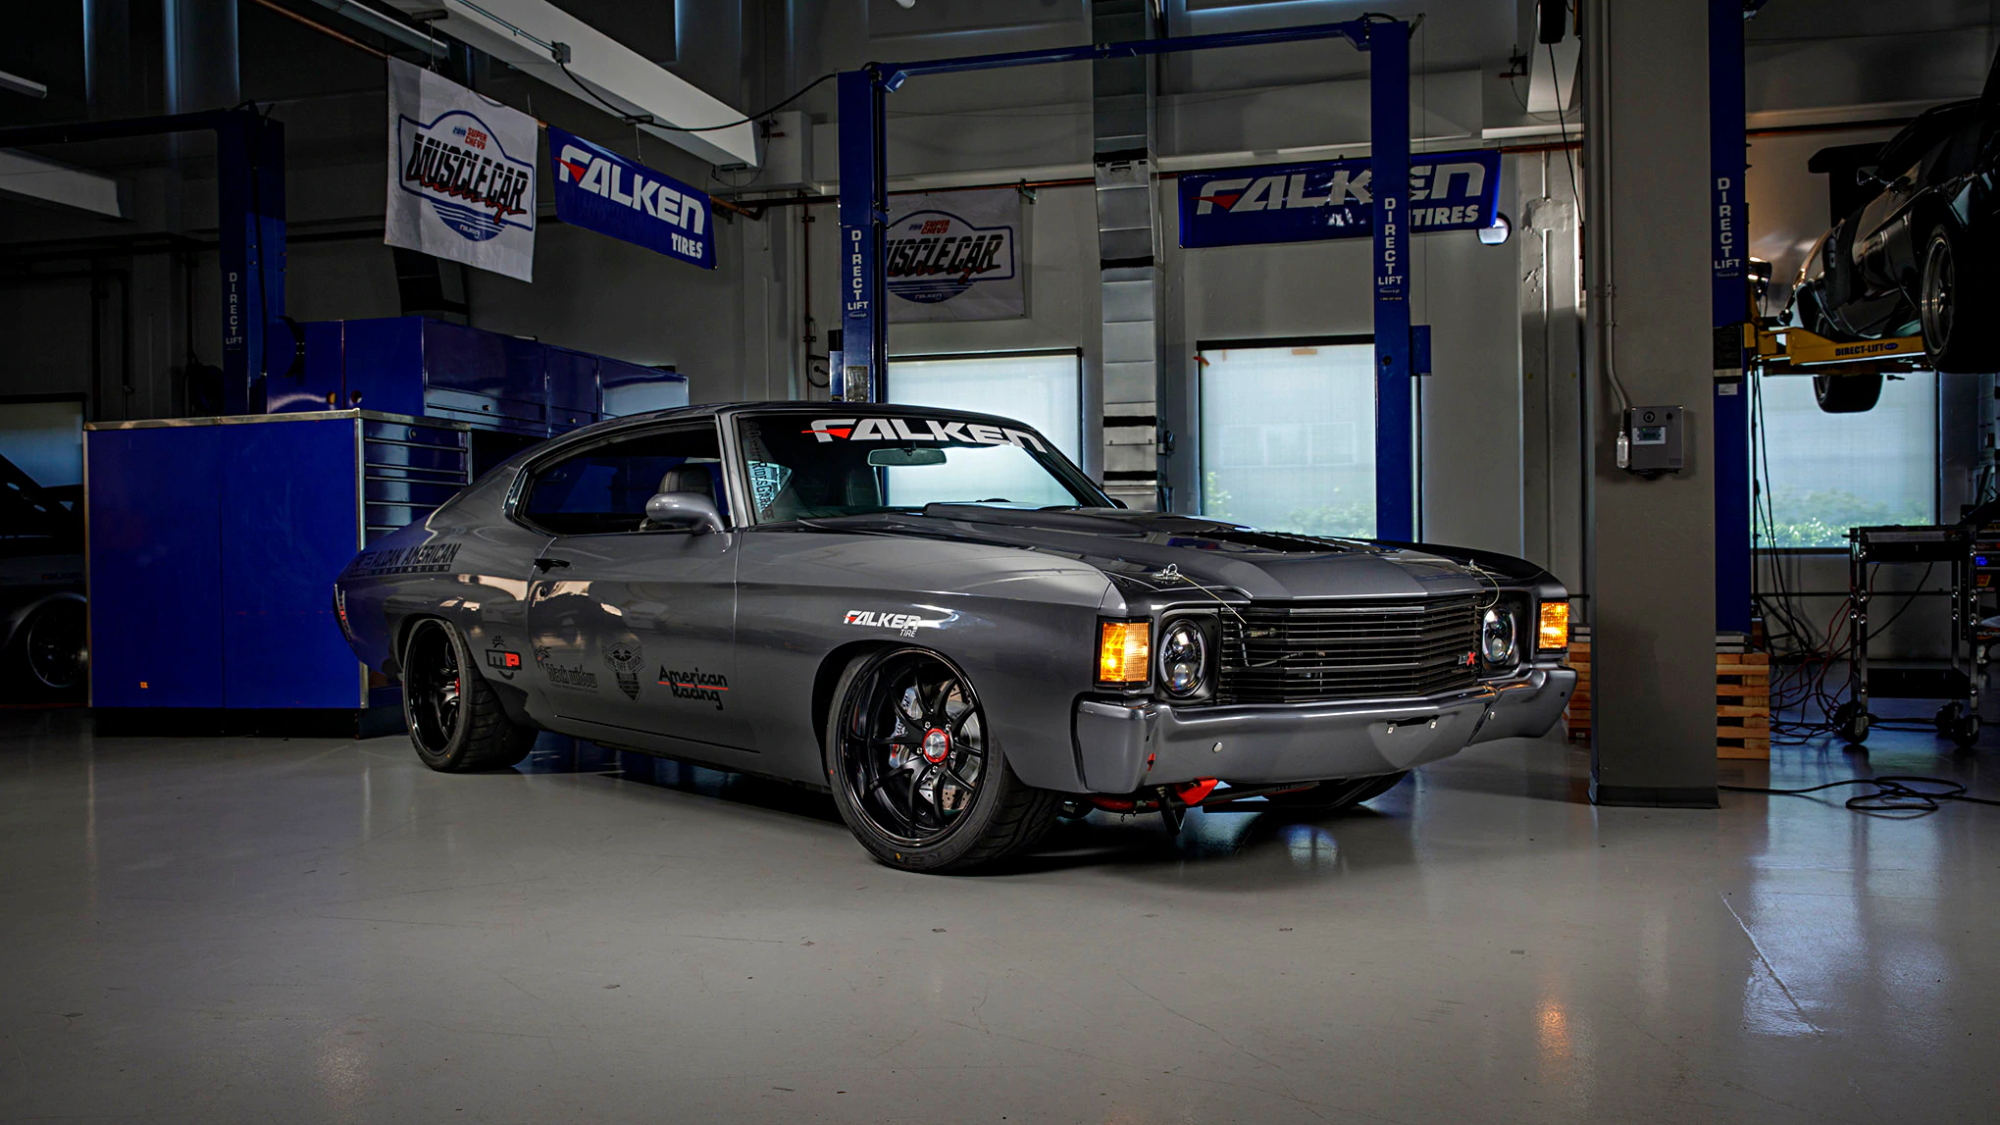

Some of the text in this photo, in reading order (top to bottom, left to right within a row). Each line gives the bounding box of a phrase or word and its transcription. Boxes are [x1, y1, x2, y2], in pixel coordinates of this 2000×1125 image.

[467, 126, 488, 141] SUPER
[555, 145, 705, 235] FALKEN
[925, 219, 950, 229] SUPER
[1411, 204, 1479, 227] TIRES
[1717, 177, 1732, 258] DIRECT
[920, 226, 948, 235] CHEVY
[1384, 197, 1397, 275] DIRECT
[671, 233, 704, 260] TIRES
[851, 229, 863, 301] DIRECT
[1714, 259, 1740, 269] LIFT
[1378, 275, 1403, 286] LIFT
[228, 272, 238, 336] DIRECT
[847, 301, 869, 311] LIFT
[225, 336, 243, 345] LIFT
[1836, 343, 1883, 356] DIRECT-LIFT
[802, 418, 1049, 454] FALKEN
[400, 542, 462, 566] AMERICAN
[659, 664, 728, 687] American
[670, 681, 724, 711] Racing
